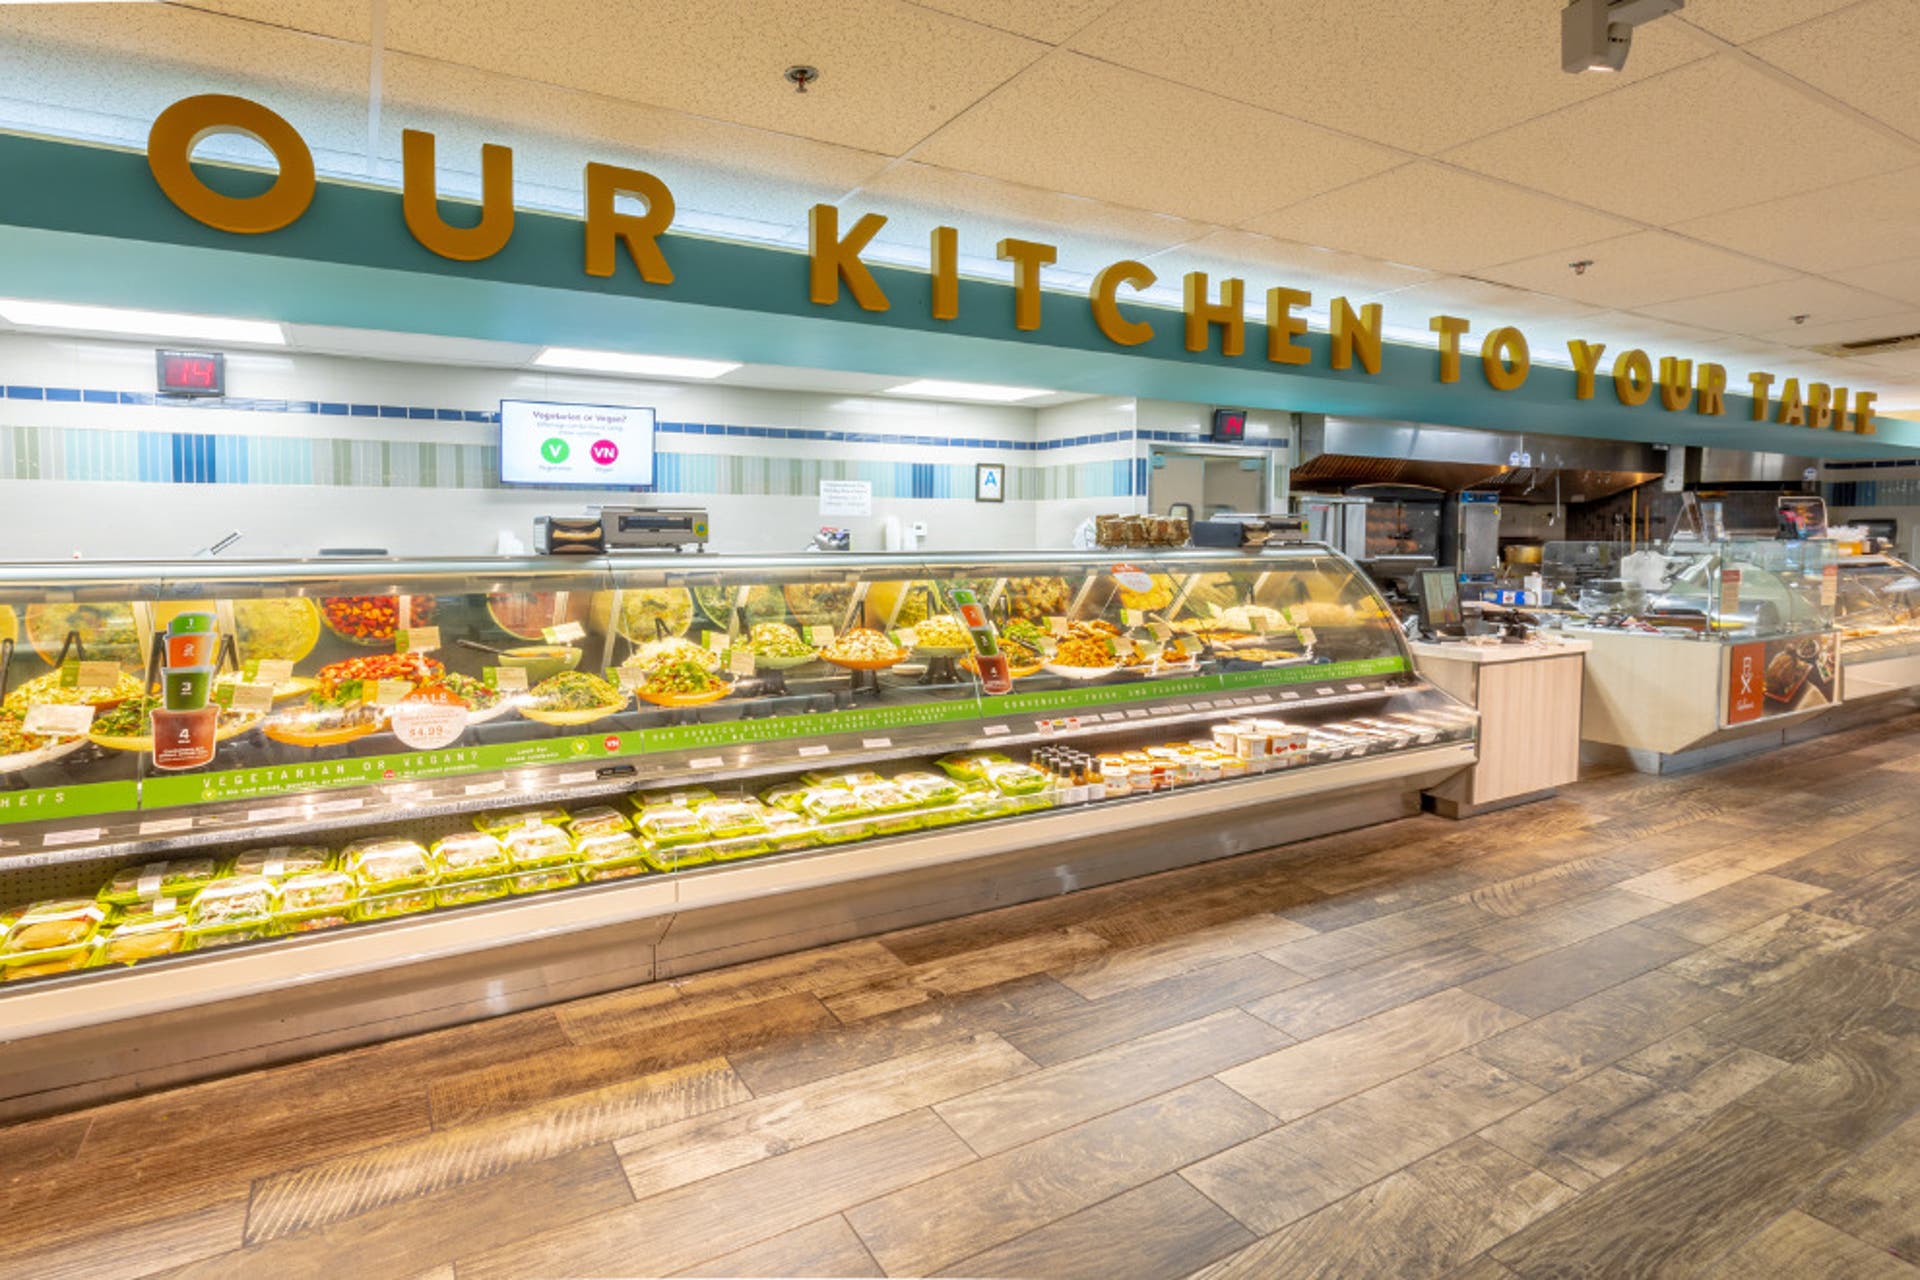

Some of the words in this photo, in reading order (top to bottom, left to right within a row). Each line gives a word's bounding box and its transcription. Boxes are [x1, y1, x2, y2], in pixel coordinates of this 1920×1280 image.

[147, 94, 675, 284] OUR
[808, 203, 1383, 375] KITCHEN
[1429, 315, 1530, 391] TO
[1567, 339, 1727, 416] YOUR
[1749, 371, 1878, 435] TABLE
[549, 444, 562, 458] V
[593, 446, 616, 459] VN
[984, 471, 997, 486] A
[180, 728, 190, 740] 4
[203, 764, 345, 788] VEGETARIAN
[362, 759, 385, 772] OR
[403, 750, 479, 767] VEGAN?
